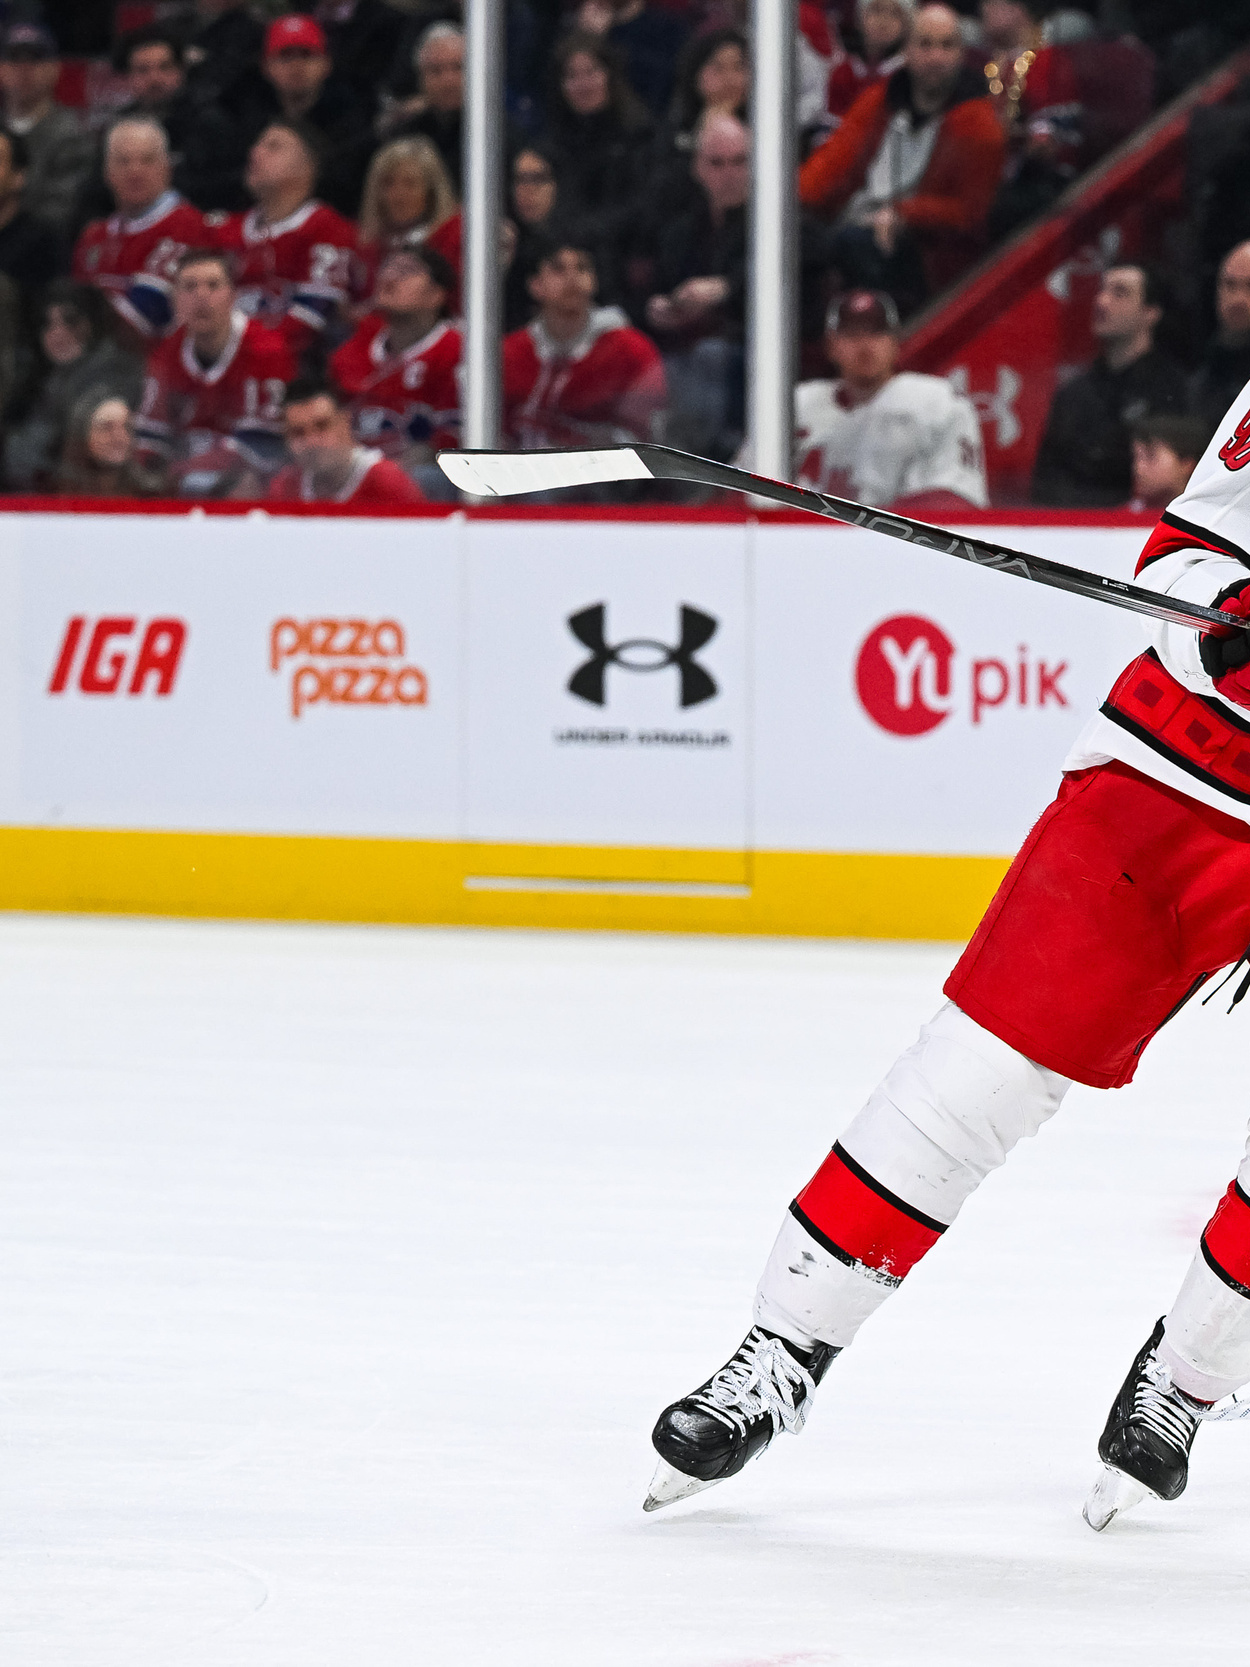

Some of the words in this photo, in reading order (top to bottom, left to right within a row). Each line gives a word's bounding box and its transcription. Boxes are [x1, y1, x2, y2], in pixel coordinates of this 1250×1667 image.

[48, 617, 187, 696] IGA
[271, 616, 406, 672] pizza
[293, 666, 428, 719] pizza
